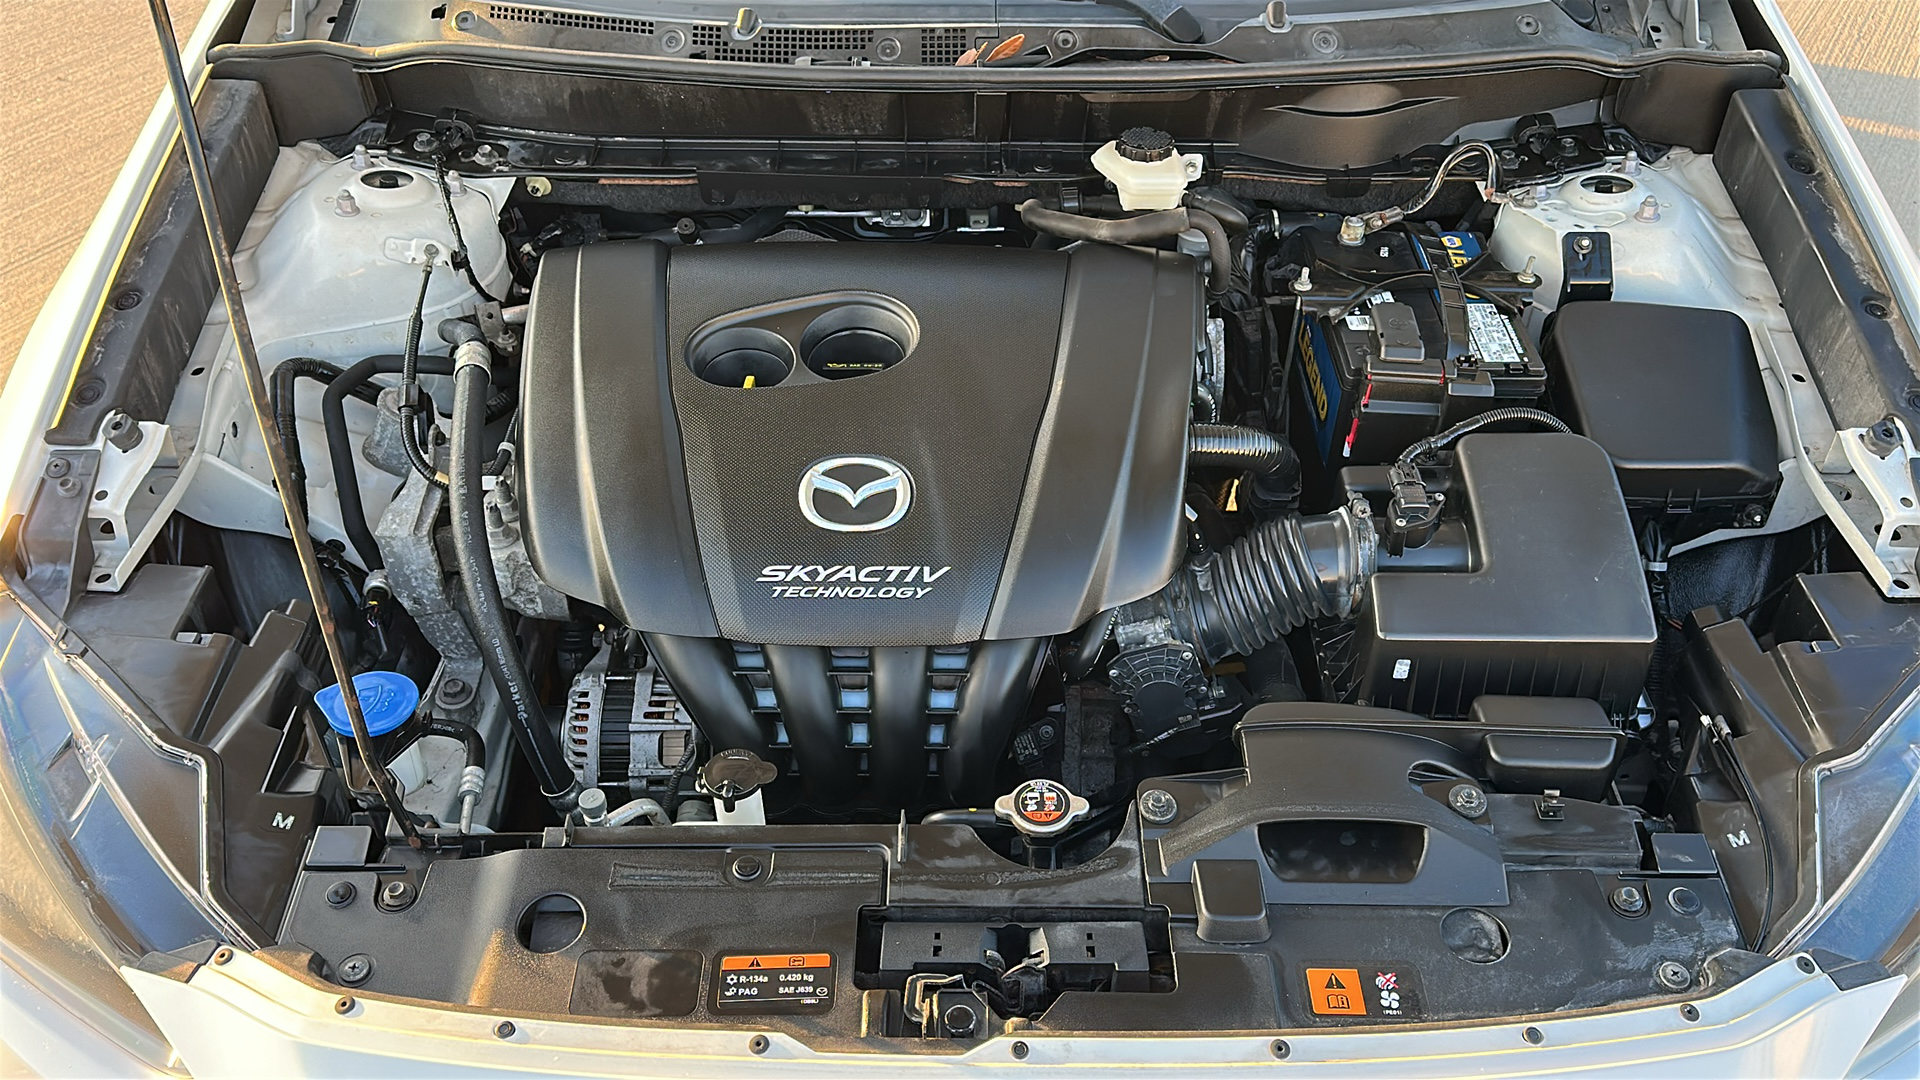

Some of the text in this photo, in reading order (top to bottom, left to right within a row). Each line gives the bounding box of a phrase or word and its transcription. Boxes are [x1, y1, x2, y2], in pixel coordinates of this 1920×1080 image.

[1298, 319, 1328, 421] LEGEND
[755, 565, 952, 583] SKYACTIV
[771, 586, 933, 599] TECHNOLOGY
[507, 681, 529, 720] Parker
[272, 812, 295, 830] M
[1726, 830, 1751, 848] M
[739, 974, 814, 983] R-134a 0.420 kg
